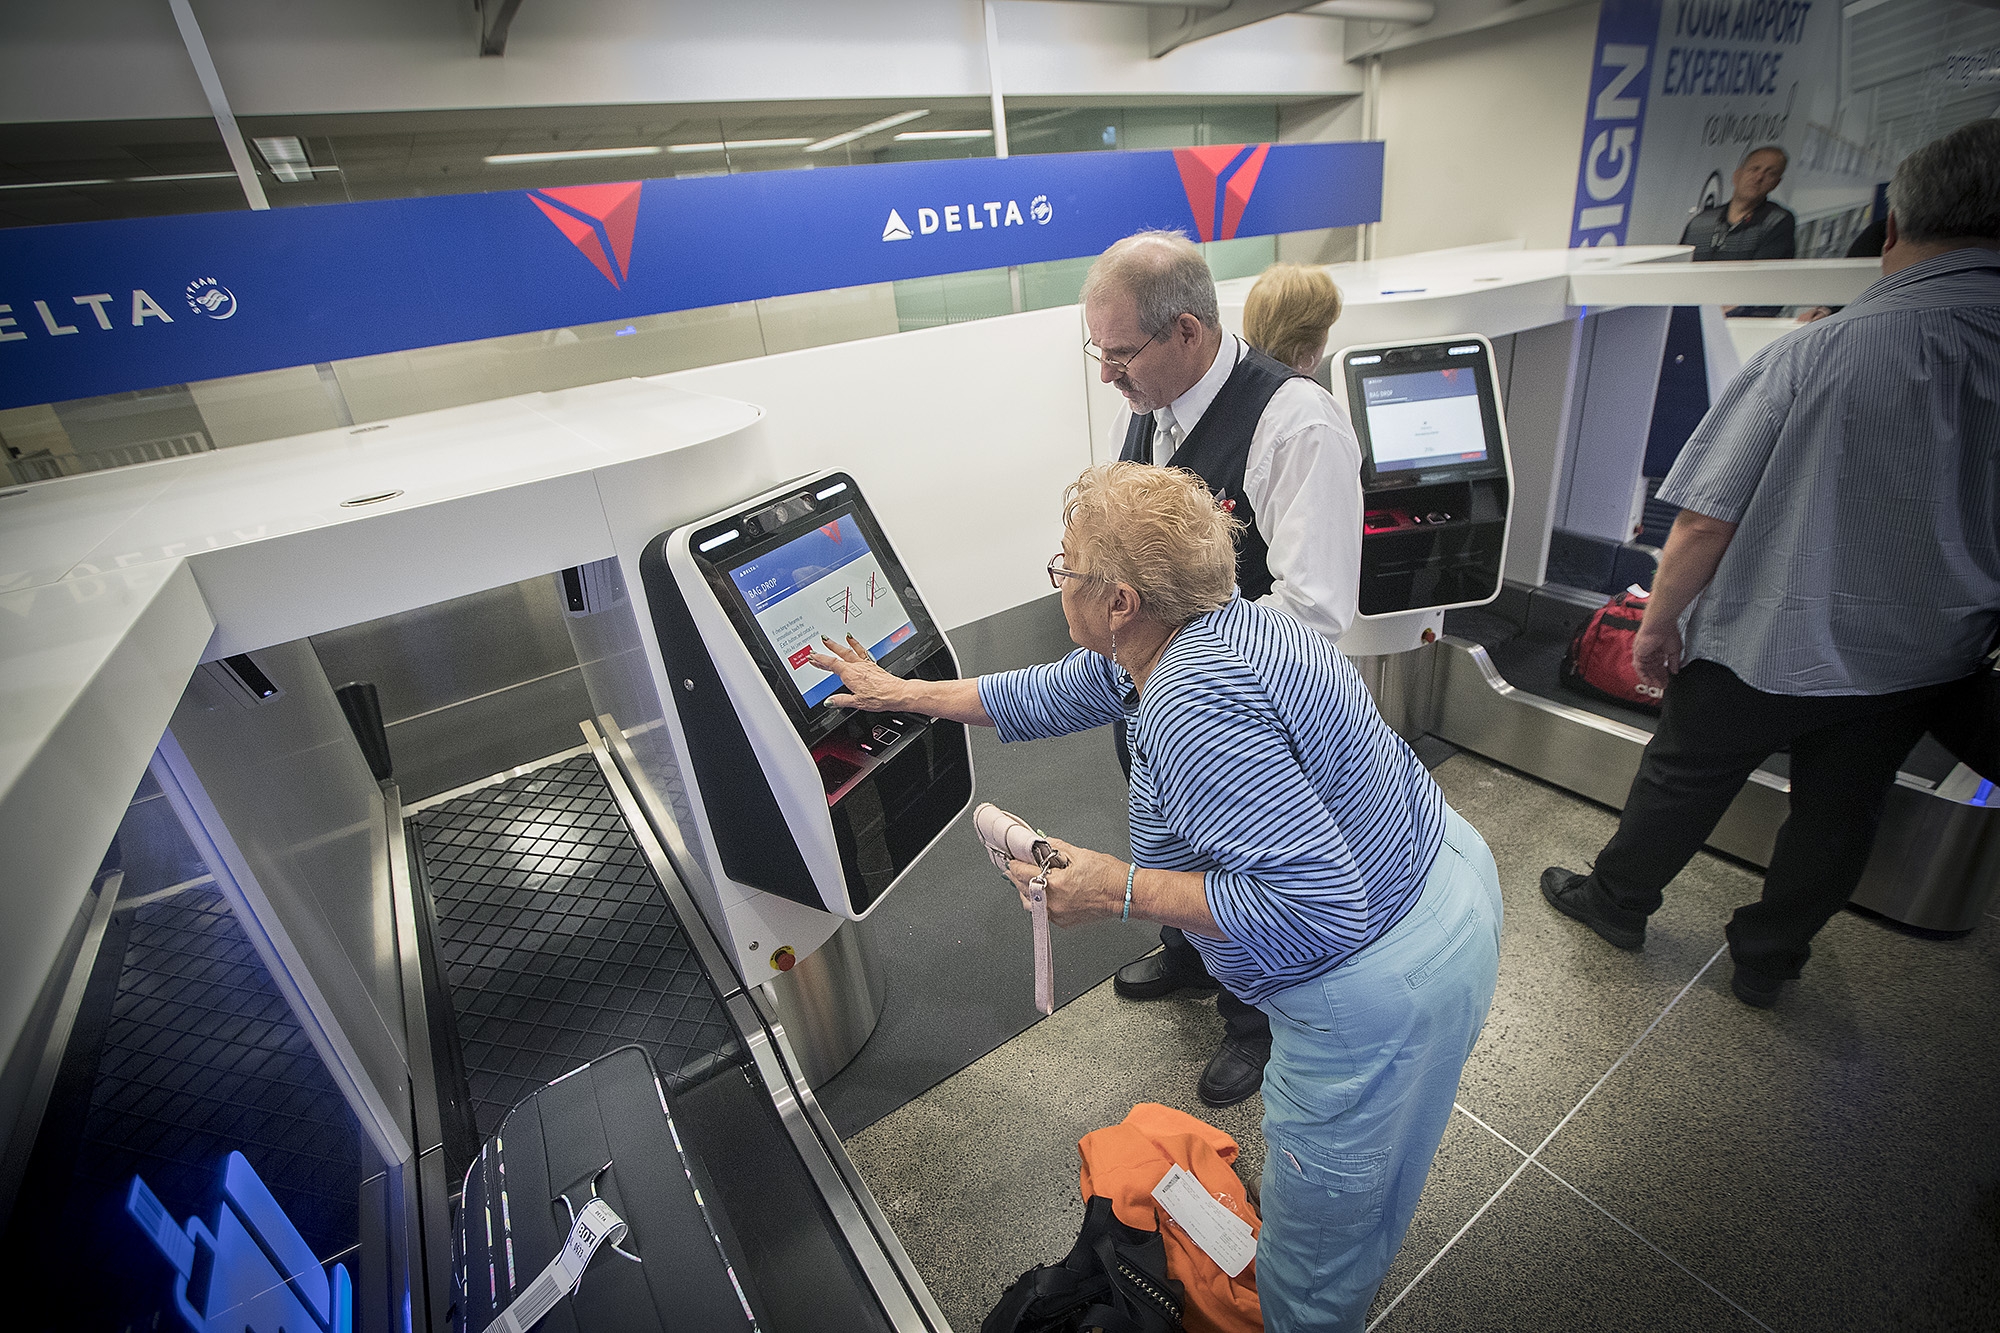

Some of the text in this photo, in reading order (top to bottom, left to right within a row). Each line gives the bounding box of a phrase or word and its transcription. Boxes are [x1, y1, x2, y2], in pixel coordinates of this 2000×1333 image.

[1676, 0, 1812, 45] YOUR AIRPORT
[1662, 46, 1784, 97] EXPERIENCE
[917, 200, 1024, 235] DELTA
[748, 577, 777, 599] BAG DROP
